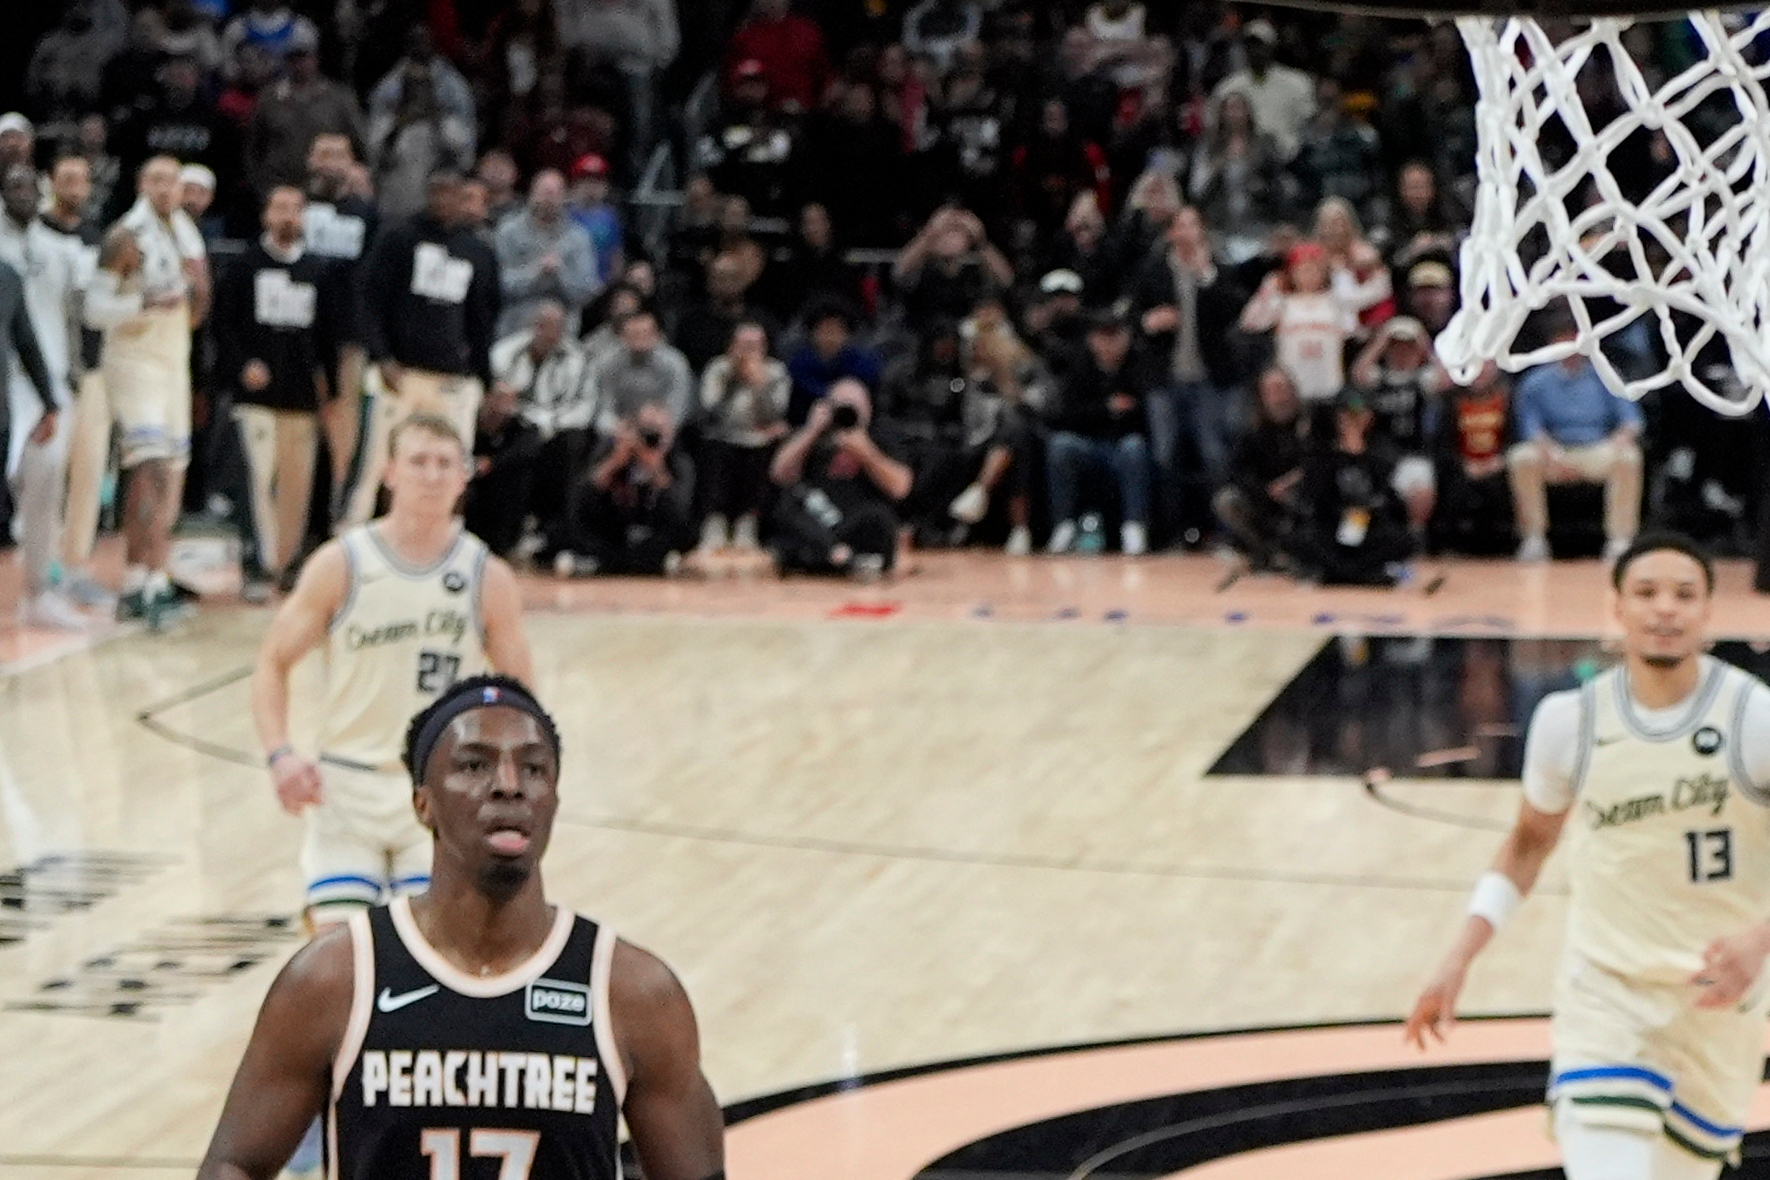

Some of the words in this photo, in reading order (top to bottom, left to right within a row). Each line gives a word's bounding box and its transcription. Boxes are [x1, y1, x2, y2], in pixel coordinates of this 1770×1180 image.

[417, 651, 462, 694] 27
[1685, 828, 1733, 884] 13
[532, 988, 586, 1012] paze
[361, 1049, 598, 1115] PEACHTREE
